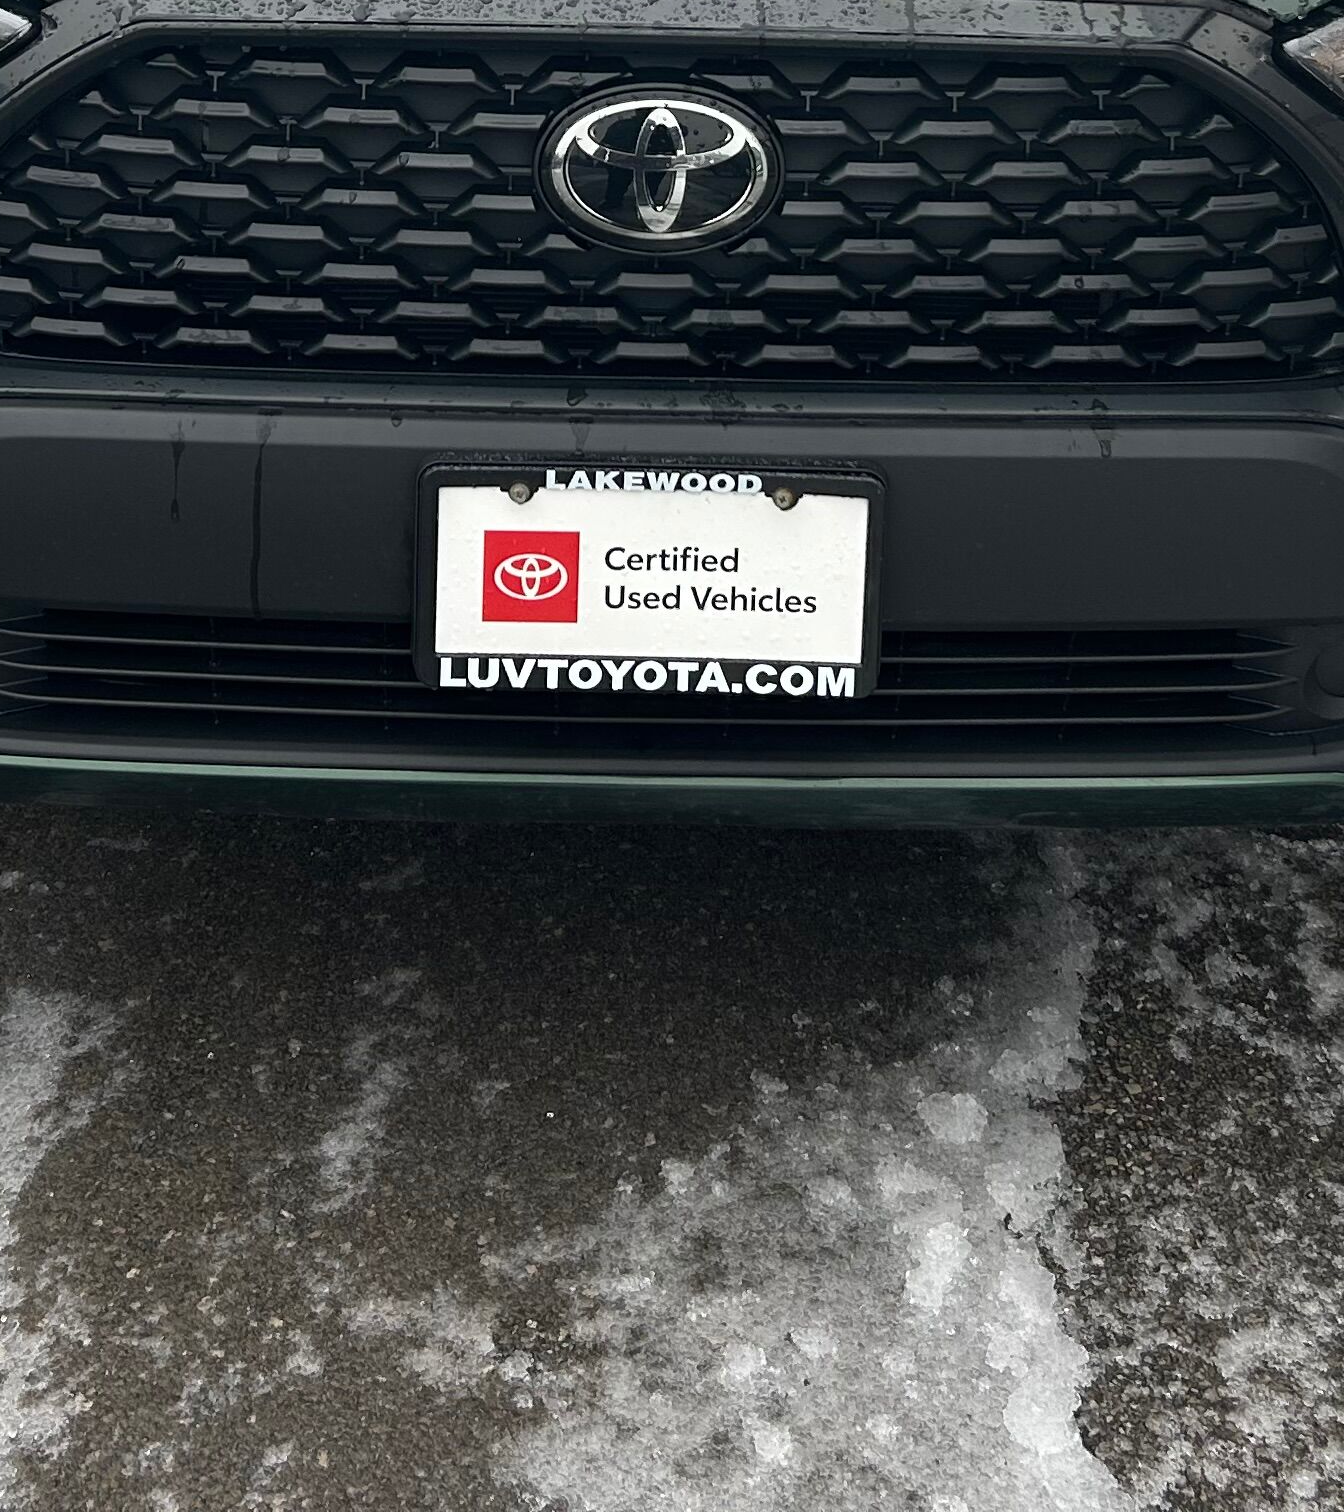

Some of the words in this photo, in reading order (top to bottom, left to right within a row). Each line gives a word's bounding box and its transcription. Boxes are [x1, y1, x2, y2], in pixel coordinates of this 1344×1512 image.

[545, 469, 763, 494] LAKEWOOD
[604, 546, 740, 573] Certified
[604, 584, 681, 610] Used
[690, 586, 818, 614] Vehicles
[439, 657, 855, 698] LUVTOYOTA.COM
